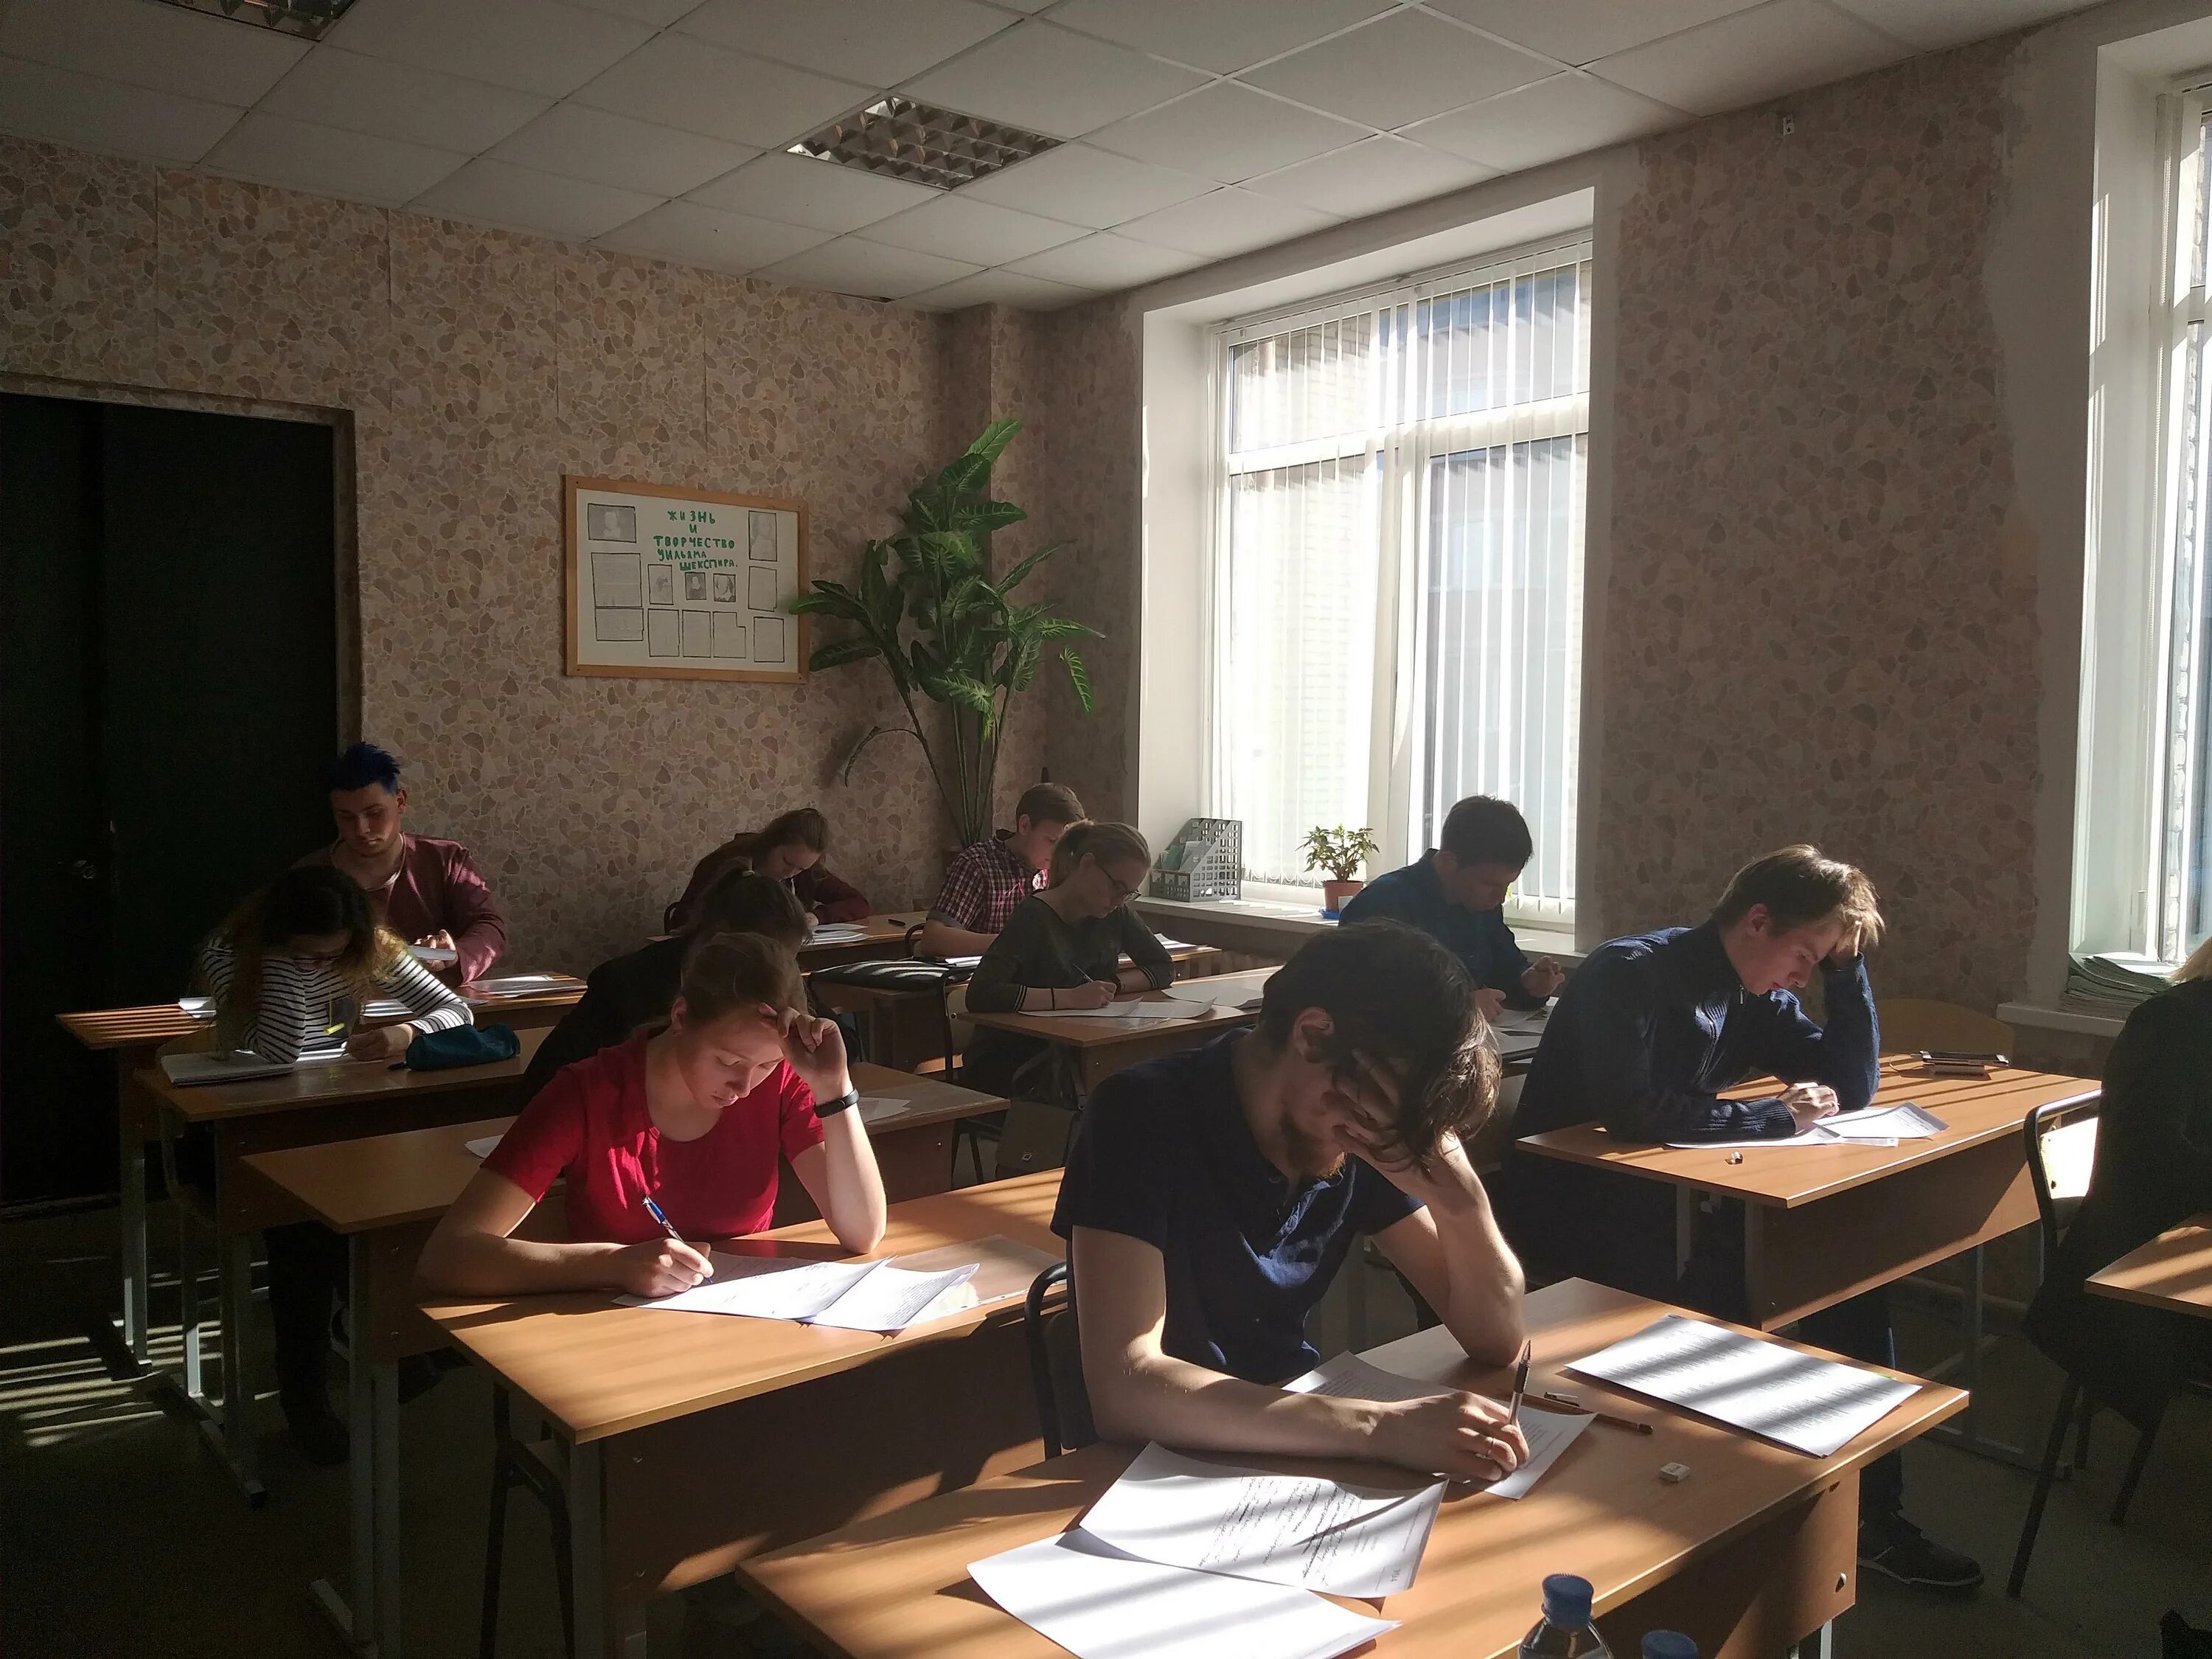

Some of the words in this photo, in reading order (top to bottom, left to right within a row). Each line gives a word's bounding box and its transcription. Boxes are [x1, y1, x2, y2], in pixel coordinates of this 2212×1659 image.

[667, 510, 715, 524] ЖИЗНЬ
[689, 524, 698, 534] И
[653, 535, 735, 549] ТВОРЧЕСТВО
[657, 549, 706, 561] УИЛЬЯМА
[679, 559, 738, 571] ШЕКСПИРА.
